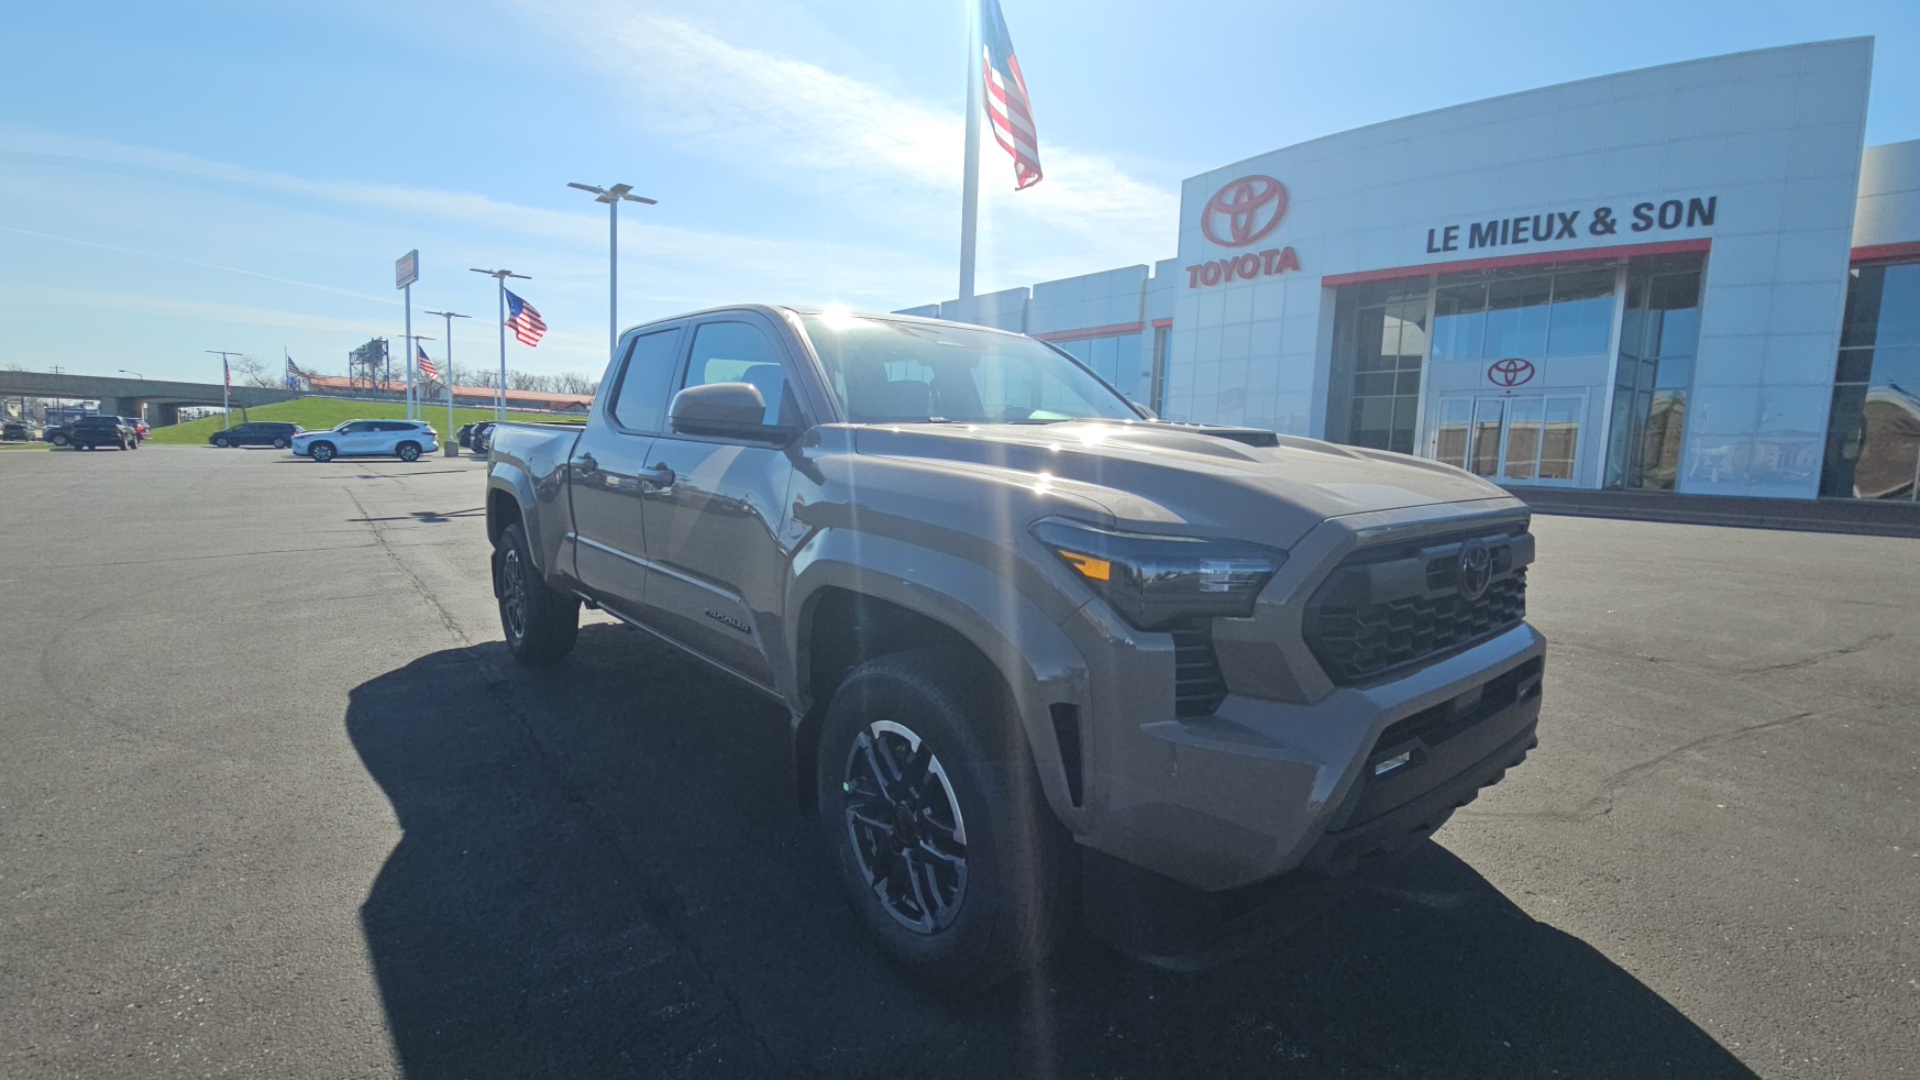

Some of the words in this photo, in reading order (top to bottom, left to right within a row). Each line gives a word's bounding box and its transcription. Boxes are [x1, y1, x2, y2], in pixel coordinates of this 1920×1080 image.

[1427, 225, 1459, 254] LE
[1468, 211, 1579, 249] MIEUX
[1589, 207, 1617, 235] &
[1631, 197, 1718, 231] SON
[1187, 246, 1300, 289] TOYOTA
